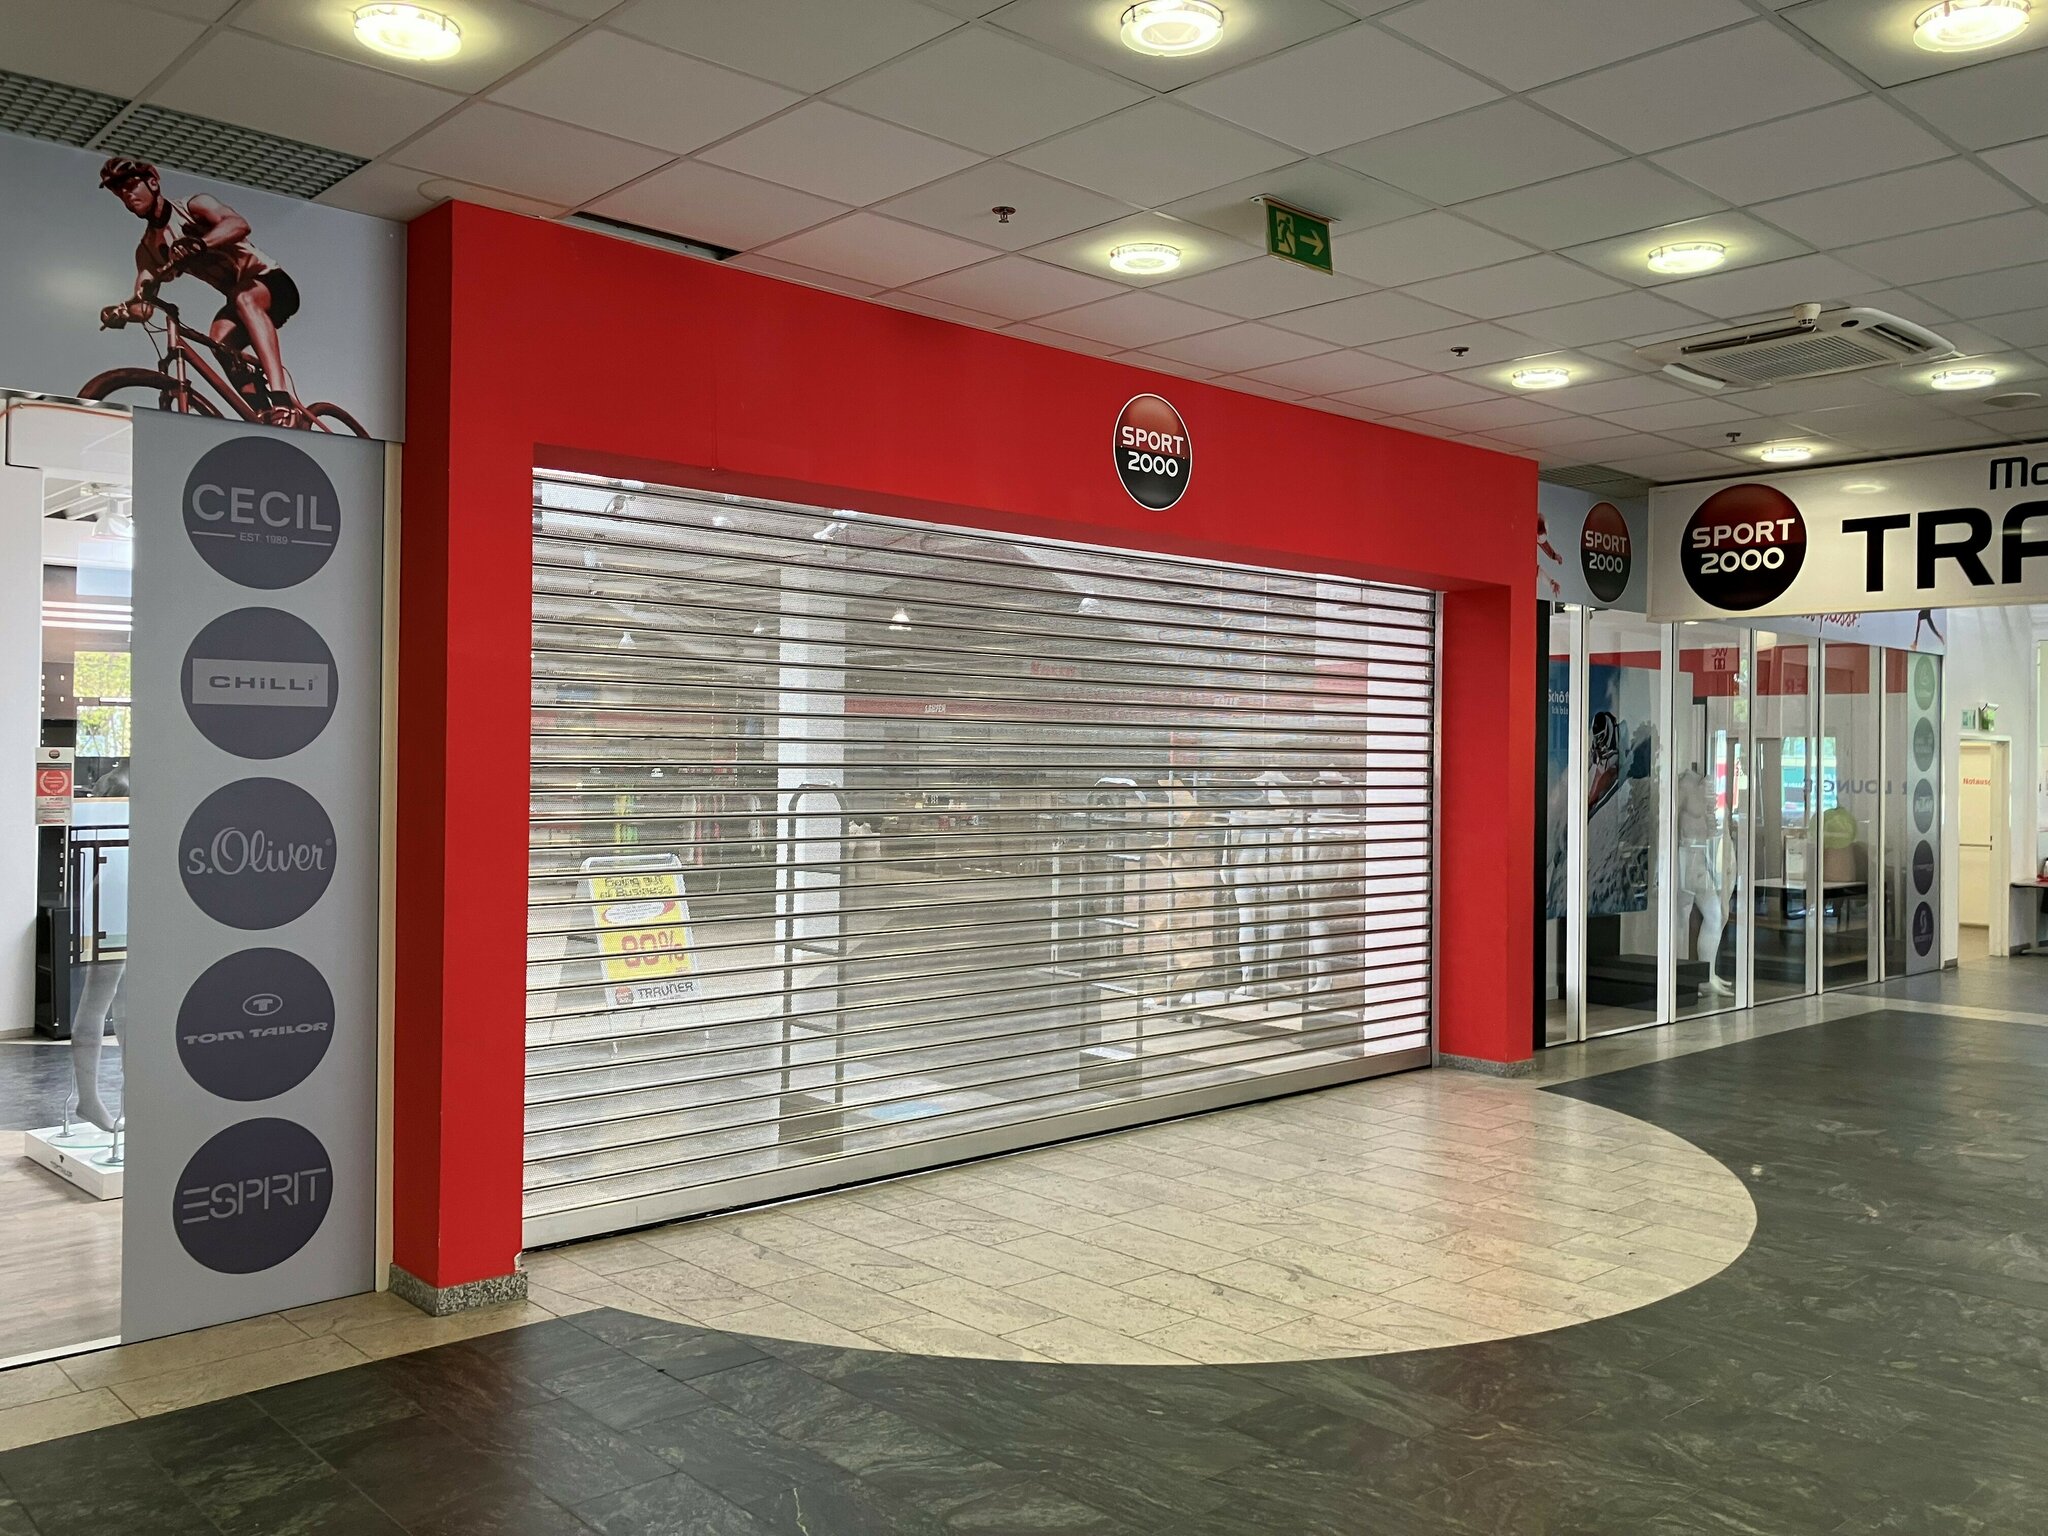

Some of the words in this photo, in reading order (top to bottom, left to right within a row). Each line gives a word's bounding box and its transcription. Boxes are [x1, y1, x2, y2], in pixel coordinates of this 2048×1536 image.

[1121, 425, 1184, 455] SPORT
[1127, 451, 1179, 478] 2000
[191, 483, 333, 532] CECIL
[265, 535, 288, 545] 1989
[1585, 530, 1627, 554] SPORT
[1692, 517, 1796, 549] SPORT
[1588, 552, 1624, 574] 2000
[1700, 546, 1785, 574] 2000
[186, 826, 328, 876] s.Oliver
[183, 1030, 244, 1045] TOM
[249, 1021, 329, 1038] TAILOR
[182, 1167, 327, 1225] ESPRIT
